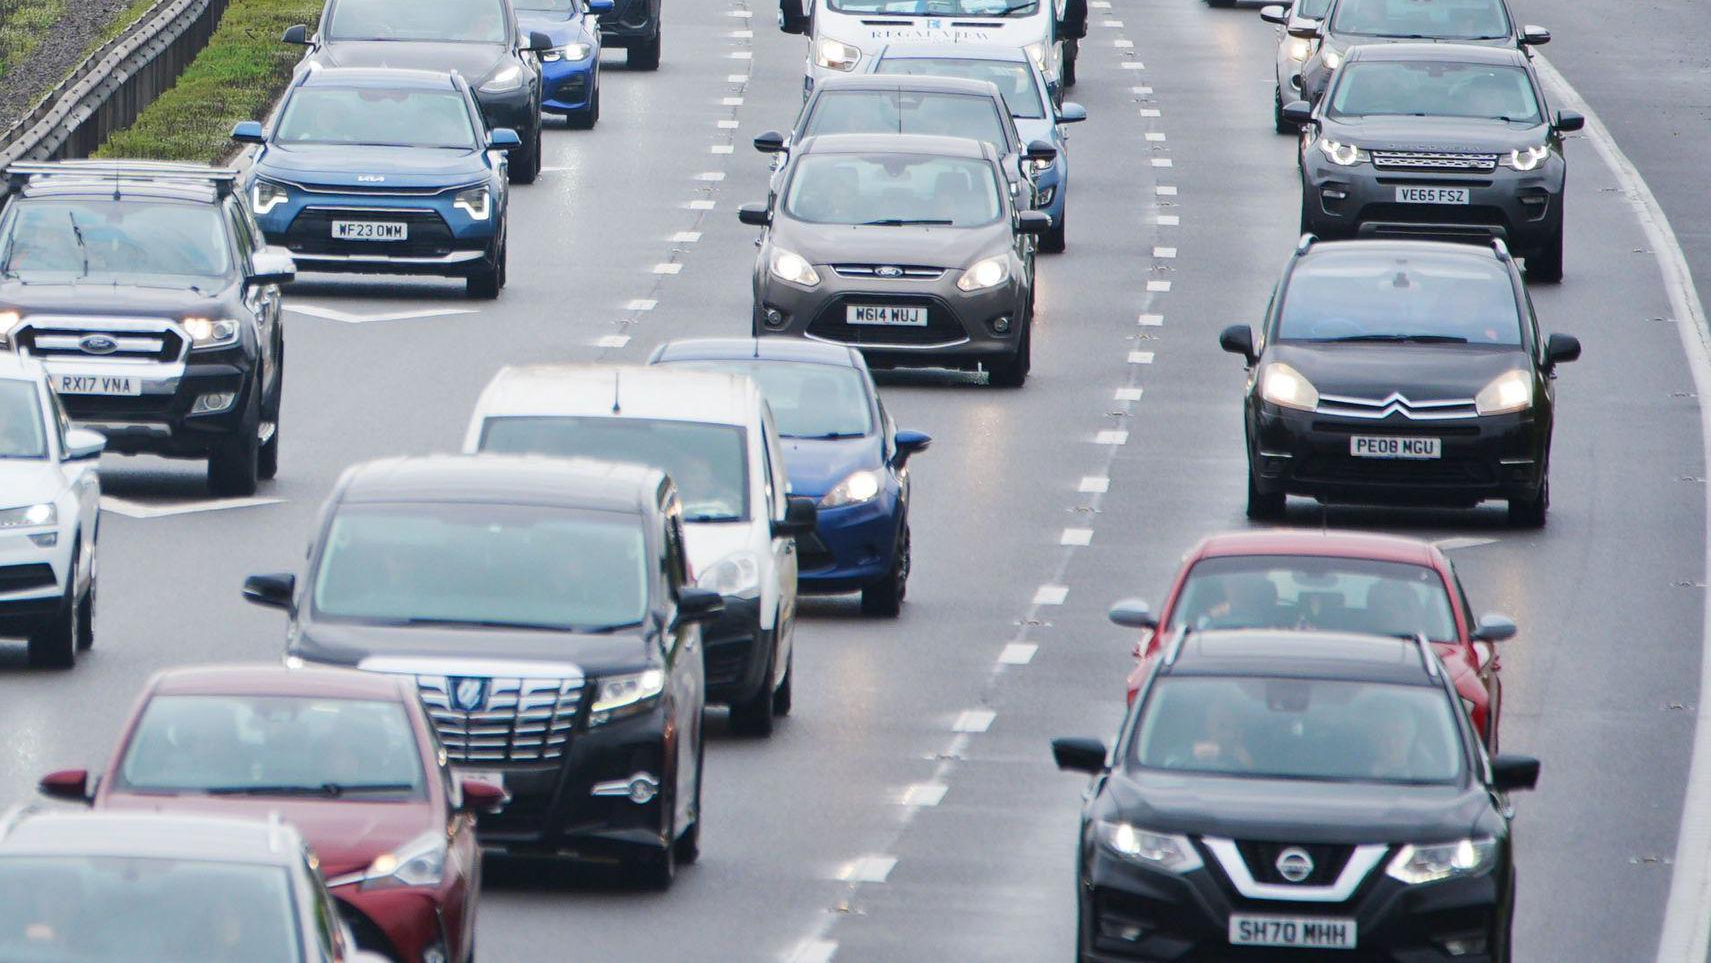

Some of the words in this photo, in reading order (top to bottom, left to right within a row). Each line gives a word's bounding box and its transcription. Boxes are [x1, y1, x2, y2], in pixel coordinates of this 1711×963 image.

[1401, 189, 1435, 201] VE65
[1438, 190, 1464, 202] FSZ
[339, 224, 373, 236] WF23
[376, 225, 402, 237] OWM
[856, 308, 887, 321] WG14
[891, 309, 918, 322] WUJ
[62, 377, 97, 391] RX17
[103, 378, 130, 393] VNA
[1357, 439, 1398, 453] PE08
[1403, 440, 1434, 454] MGU
[1239, 921, 1295, 943] SH70
[1302, 923, 1346, 944] MHH
